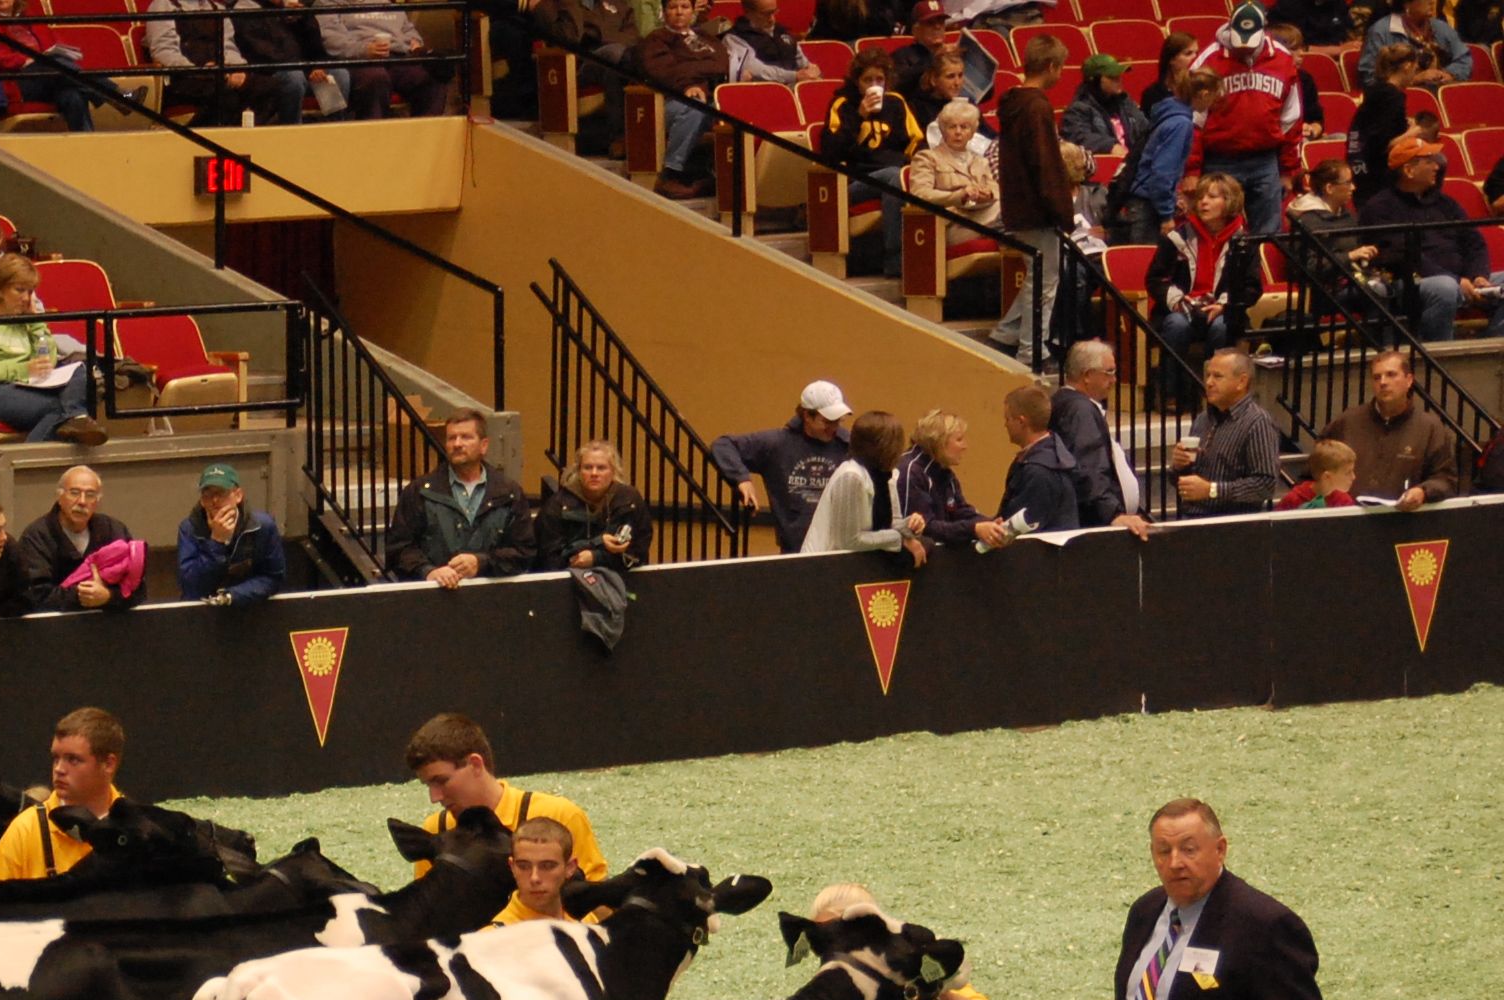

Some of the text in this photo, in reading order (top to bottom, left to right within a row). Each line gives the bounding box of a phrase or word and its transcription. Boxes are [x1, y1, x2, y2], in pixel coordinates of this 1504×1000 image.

[548, 68, 558, 85] G
[637, 107, 645, 124] F
[819, 186, 829, 203] D
[914, 228, 925, 246] C
[1015, 271, 1025, 289] B
[788, 475, 807, 487] RED
